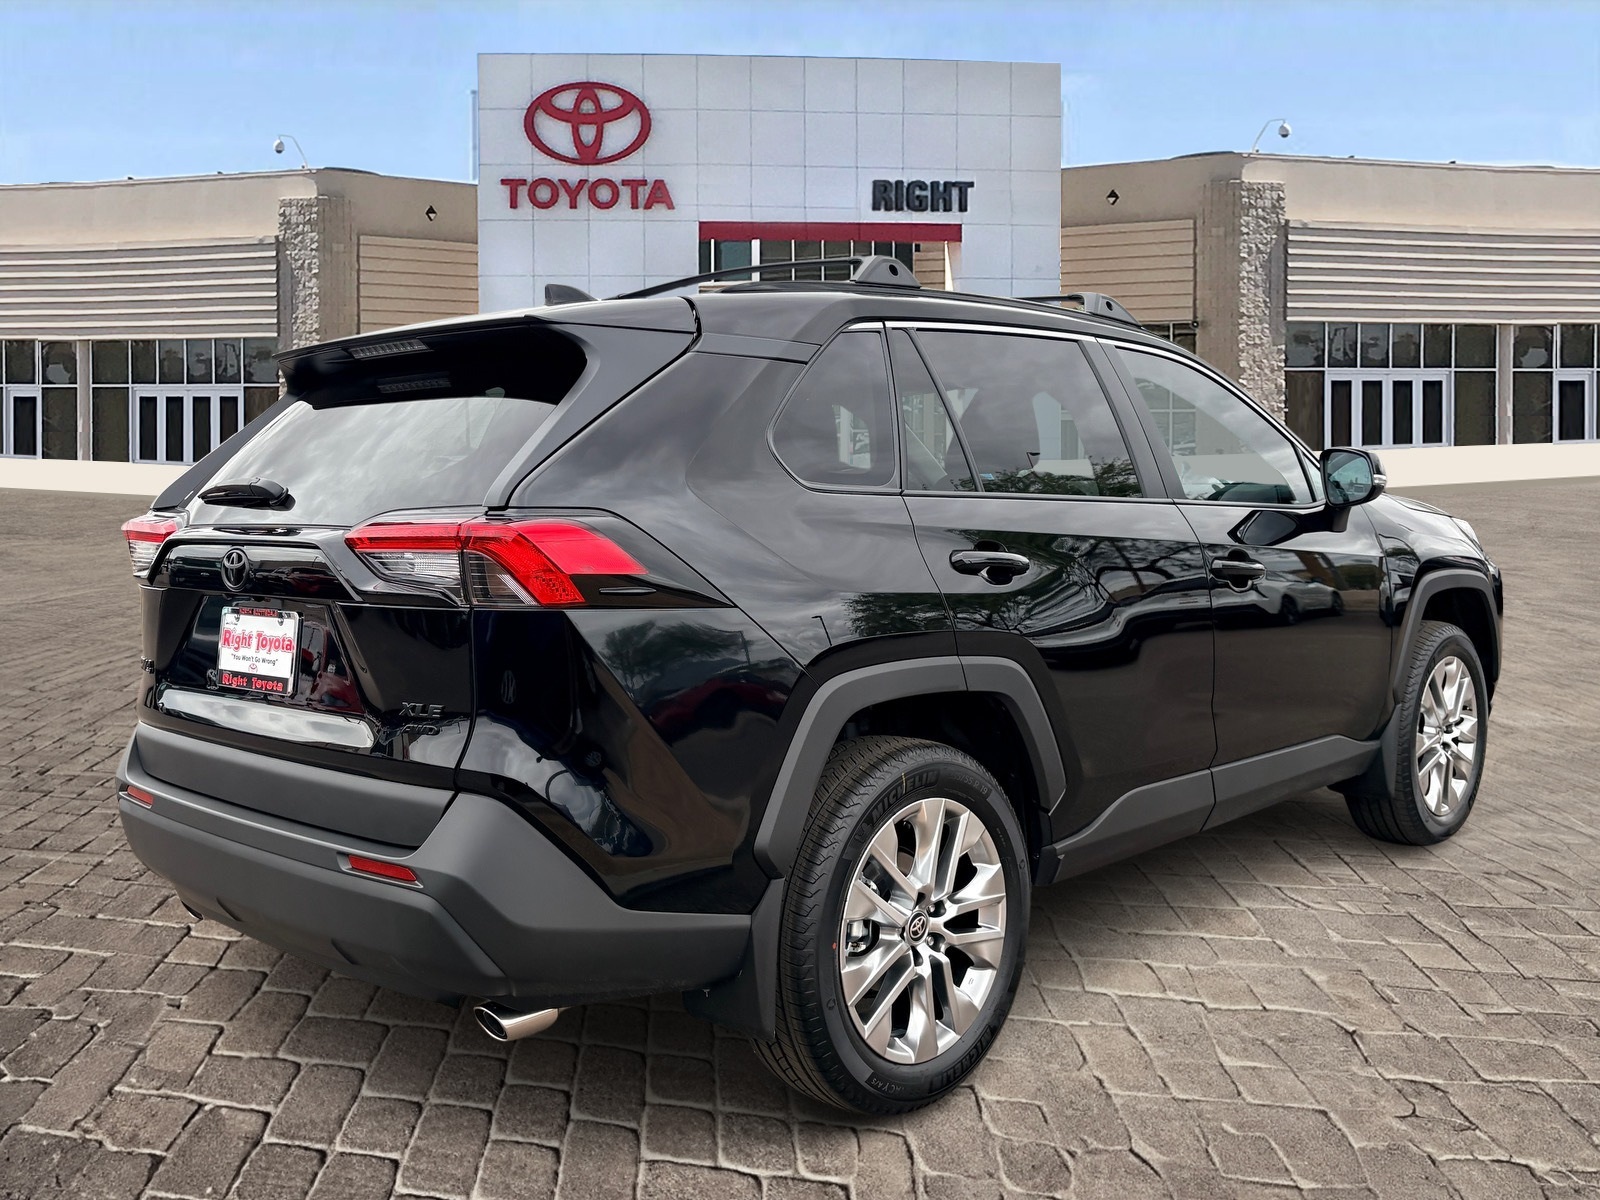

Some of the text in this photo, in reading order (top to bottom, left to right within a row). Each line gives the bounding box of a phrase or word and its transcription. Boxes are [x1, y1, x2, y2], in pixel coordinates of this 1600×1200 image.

[500, 178, 675, 210] TOYOTA
[872, 179, 975, 212] RIGHT
[222, 628, 294, 654] Right Toyota
[222, 673, 283, 691] Right Toyota
[399, 702, 444, 717] XLE
[872, 769, 939, 823] MICHELIN
